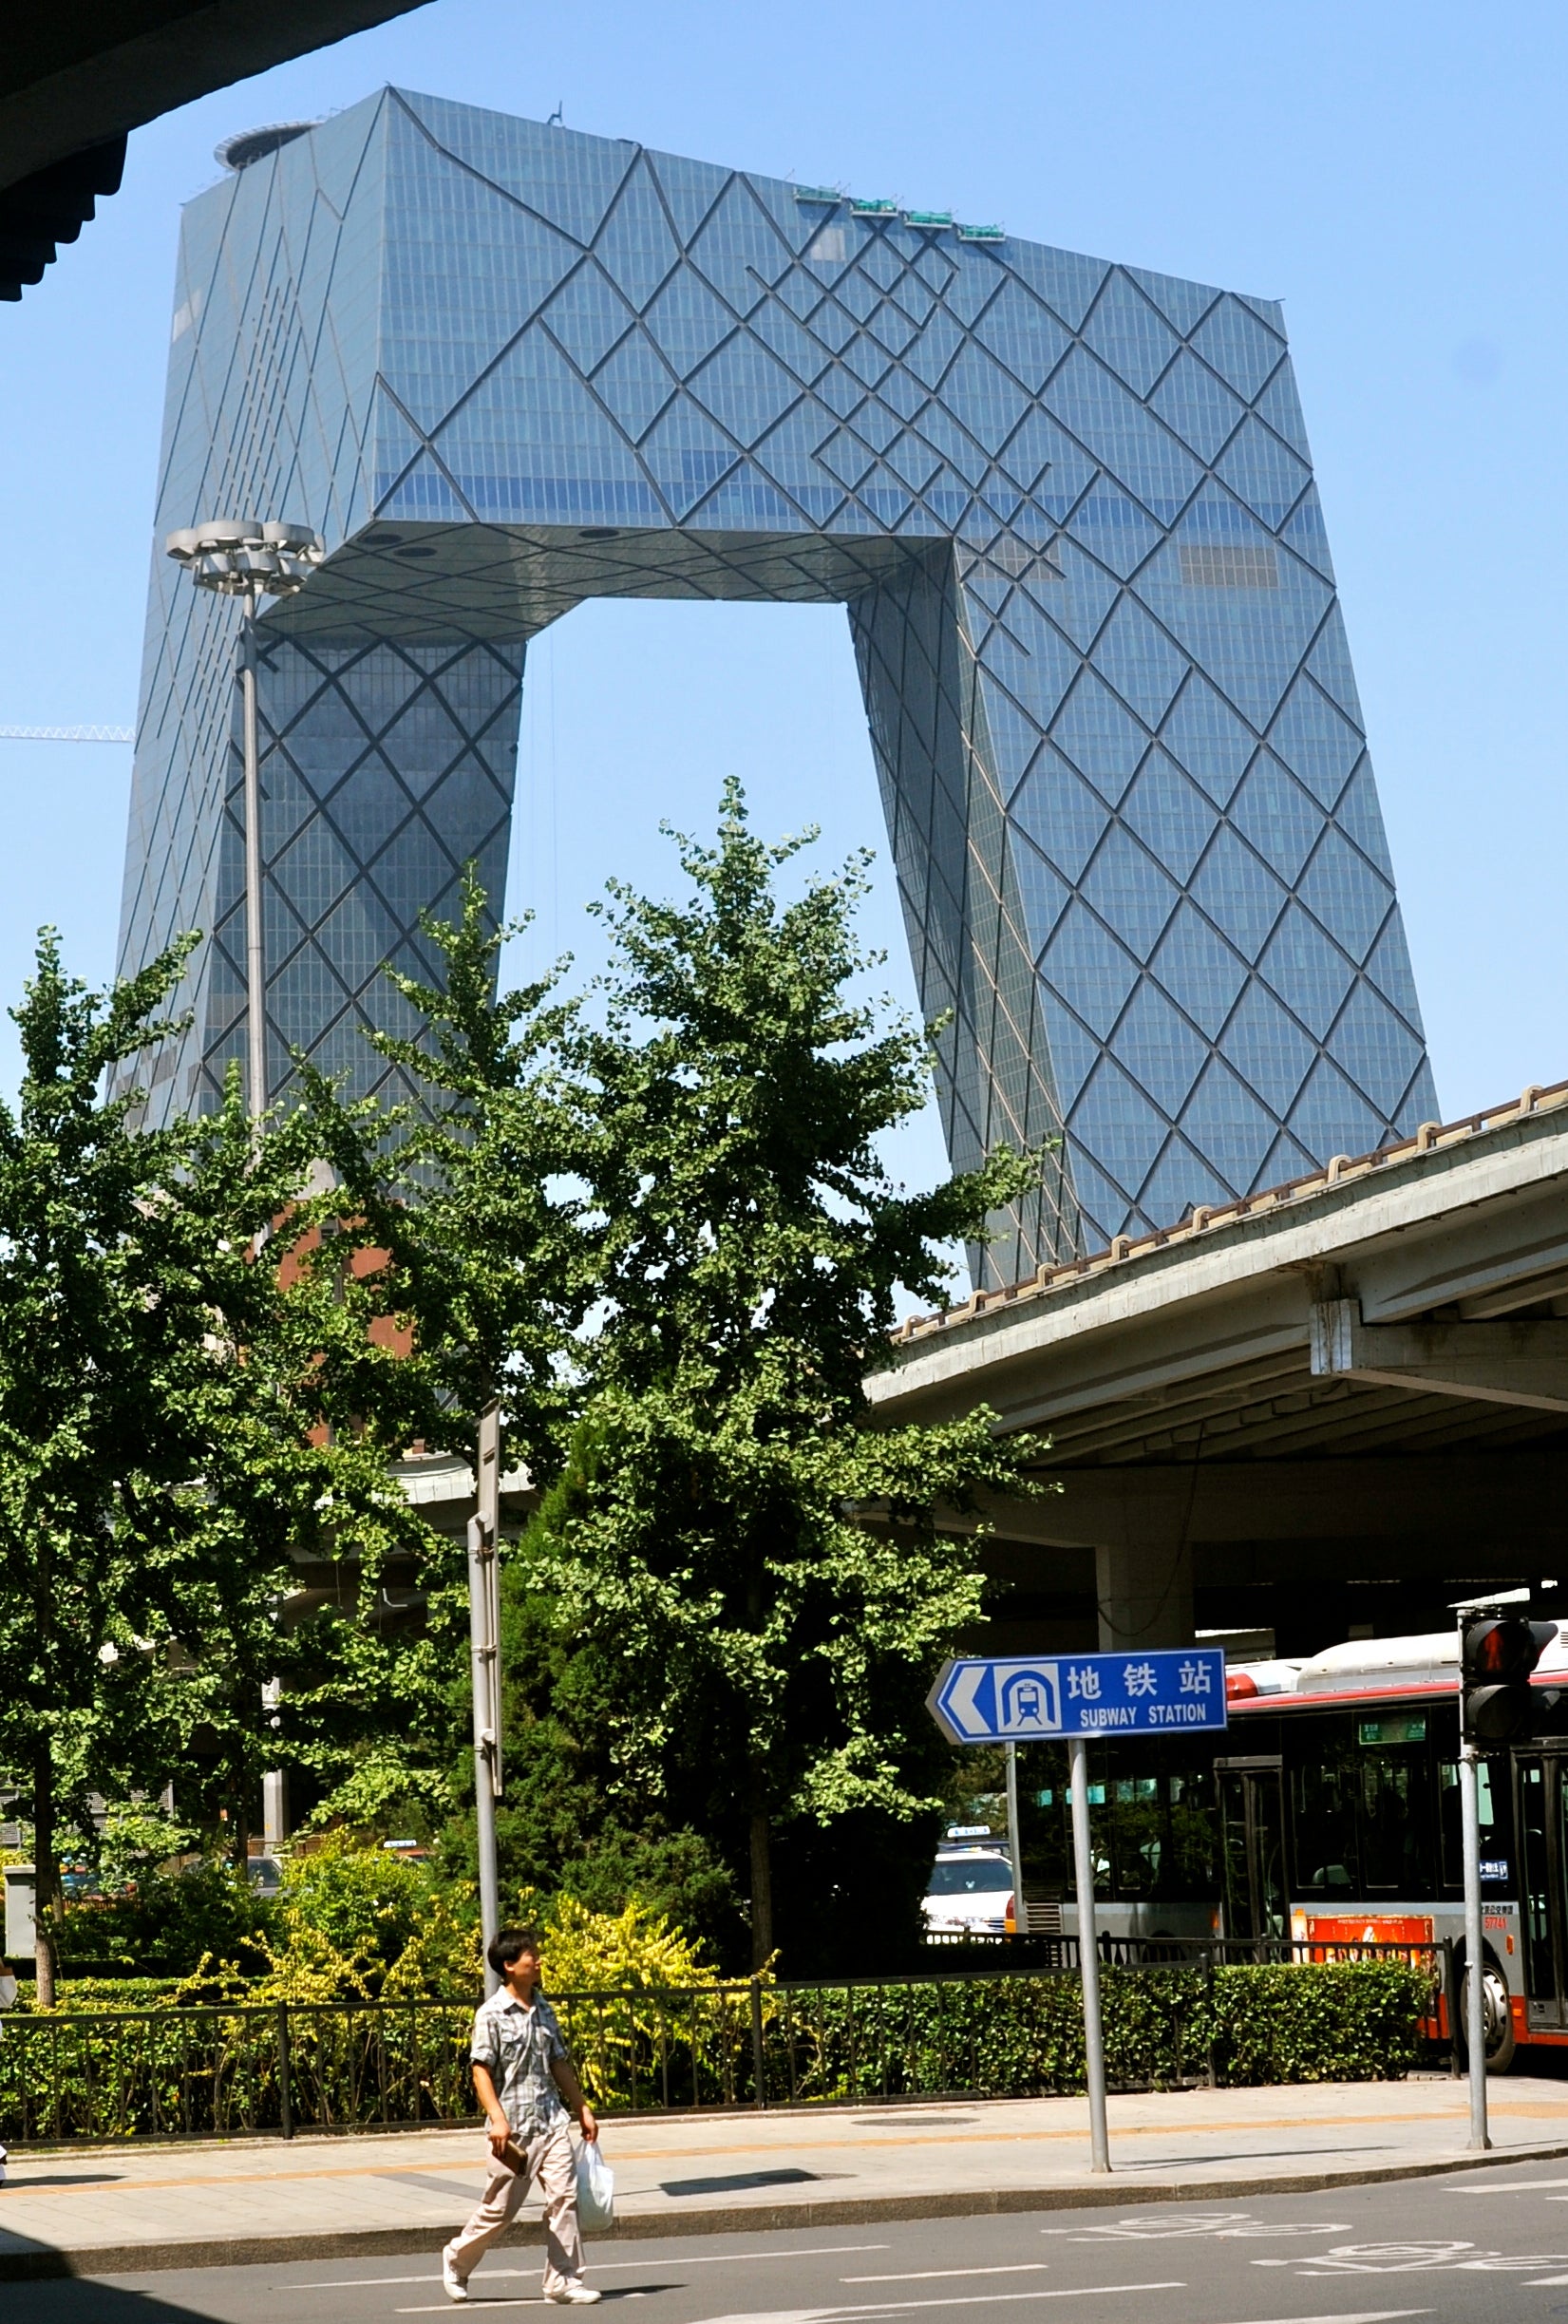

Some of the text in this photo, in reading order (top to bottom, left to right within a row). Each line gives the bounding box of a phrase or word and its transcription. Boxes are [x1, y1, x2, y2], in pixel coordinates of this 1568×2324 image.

[1067, 1661, 1212, 1700] 地铁站
[1080, 1703, 1206, 1728] SUBWAY STATION
